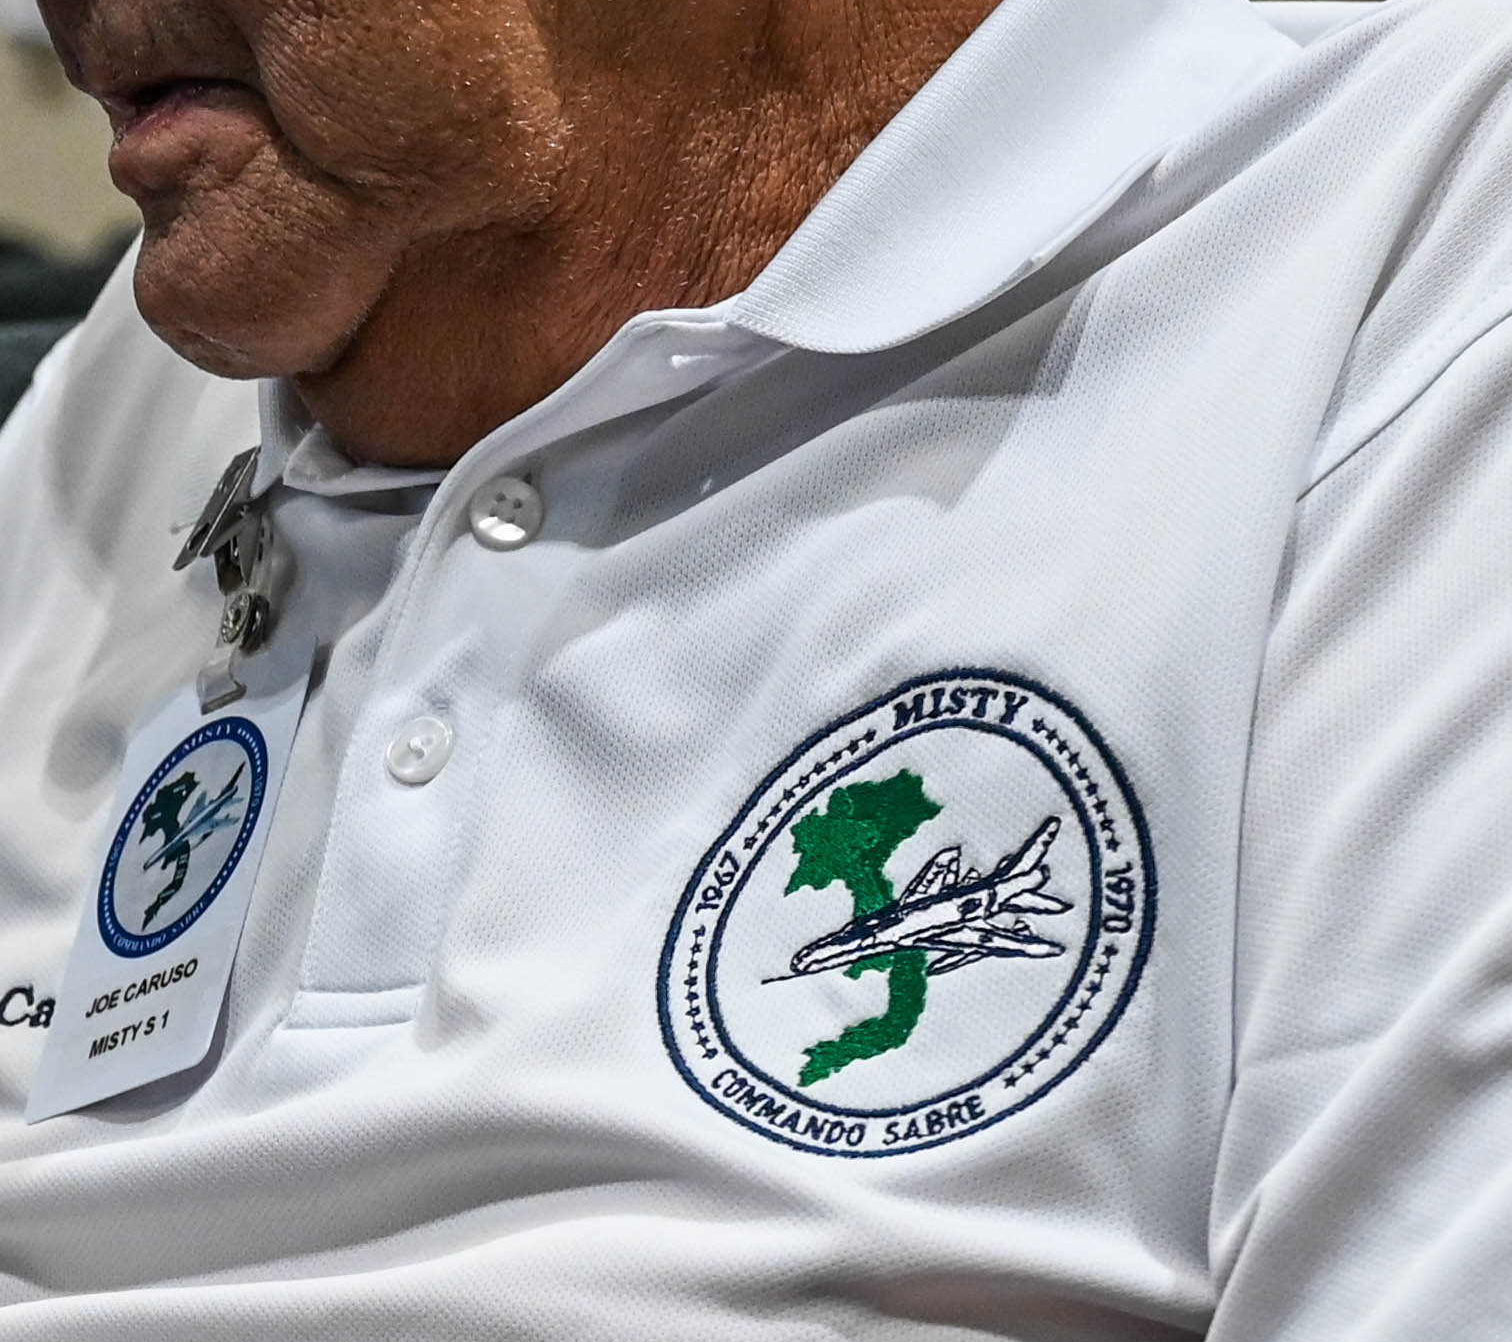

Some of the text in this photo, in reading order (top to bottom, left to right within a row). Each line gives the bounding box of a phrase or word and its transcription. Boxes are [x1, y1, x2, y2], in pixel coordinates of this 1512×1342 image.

[892, 686, 1029, 731] MISTY
[695, 850, 743, 914] 1967
[1099, 860, 1136, 934] 1970
[85, 958, 198, 1018] JOE CARUSO
[88, 1020, 143, 1059] MISTY
[710, 1067, 986, 1146] COMMANDO SABRE
